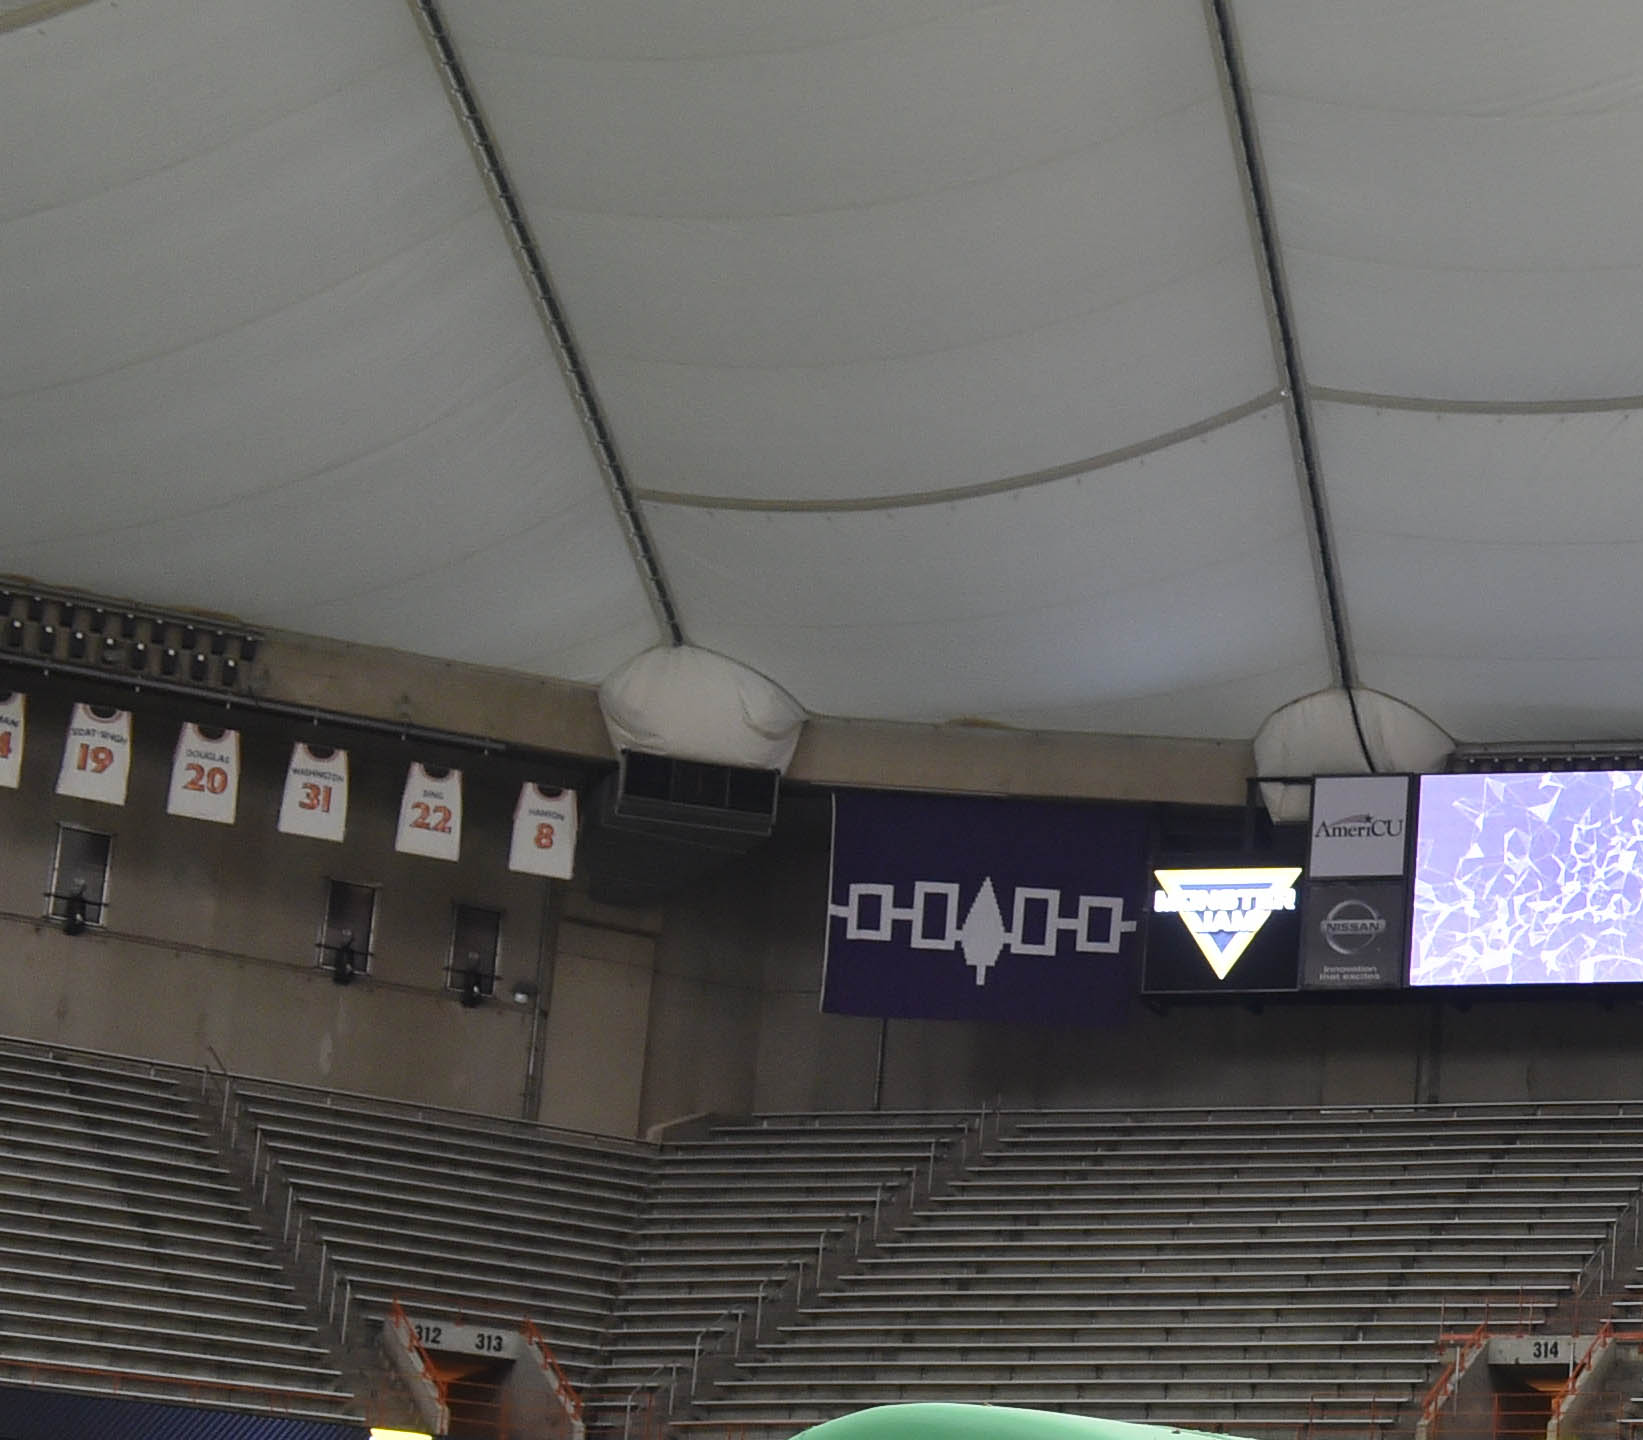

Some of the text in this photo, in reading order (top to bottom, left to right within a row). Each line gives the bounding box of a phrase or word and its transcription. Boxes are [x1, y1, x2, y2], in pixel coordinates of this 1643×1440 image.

[77, 743, 114, 774] 19
[186, 749, 230, 764] DOUGLAS
[183, 763, 228, 795] 20
[292, 767, 344, 783] WASHINGTON
[298, 783, 333, 814] 31
[410, 802, 452, 834] 22
[534, 823, 554, 849] 8
[1315, 819, 1403, 838] AmeriCU
[1326, 922, 1379, 932] NISSAN
[414, 1325, 442, 1345] 312
[475, 1333, 503, 1352] 313
[1533, 1341, 1559, 1358] 314
